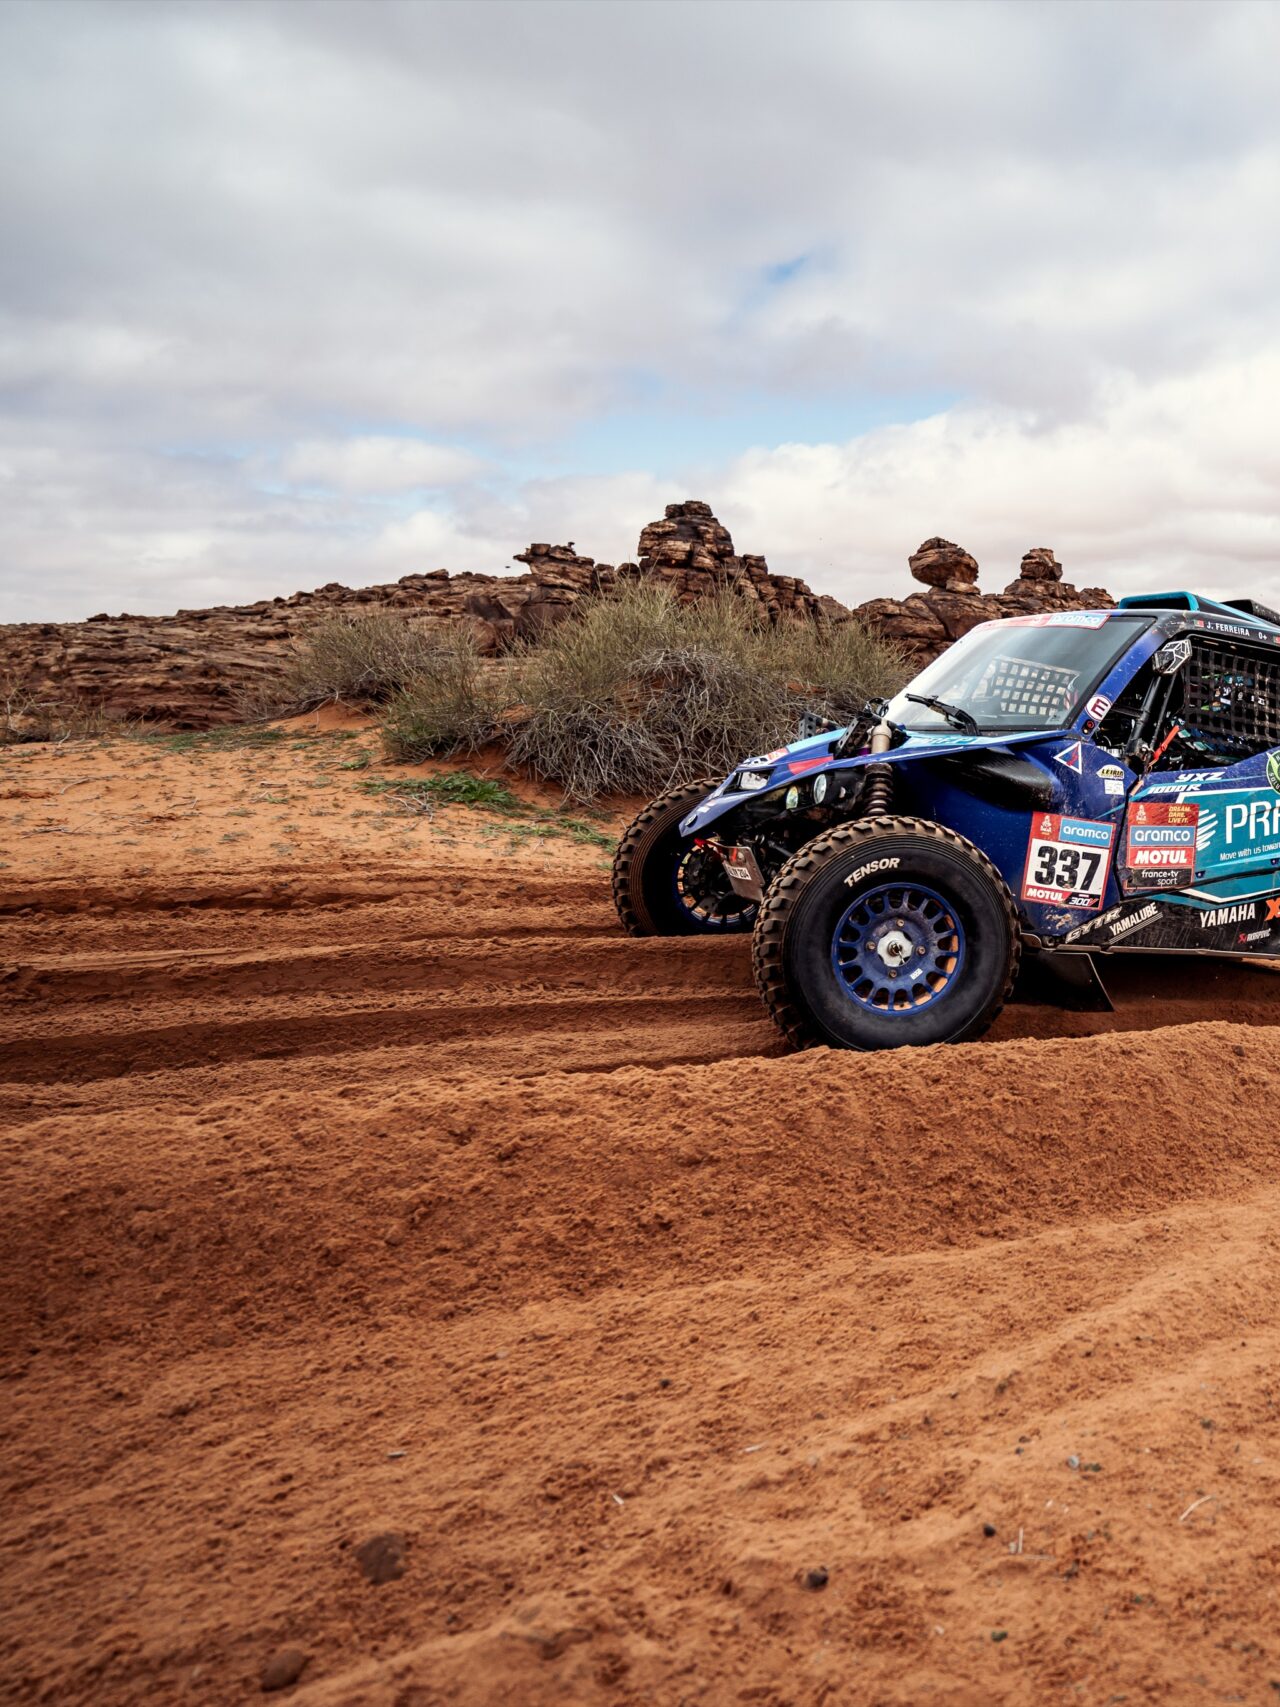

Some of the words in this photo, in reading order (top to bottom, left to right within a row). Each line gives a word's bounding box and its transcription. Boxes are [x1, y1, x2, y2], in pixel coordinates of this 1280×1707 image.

[1054, 614, 1099, 624] aramco
[1206, 621, 1214, 630] J.
[1216, 623, 1250, 637] FERREIRA
[1063, 825, 1109, 840] aramco
[1134, 830, 1190, 842] aramco
[1134, 850, 1187, 865] MOTUL
[1220, 852, 1237, 861] Move
[1238, 848, 1252, 858] with
[1253, 846, 1261, 854] us
[843, 857, 901, 887] TENSOR
[1034, 845, 1102, 891] 337
[1157, 878, 1178, 888] sport
[1026, 888, 1065, 901] MOTUL
[1109, 902, 1159, 936] YAMALUBE
[1199, 903, 1256, 929] YAMAHA
